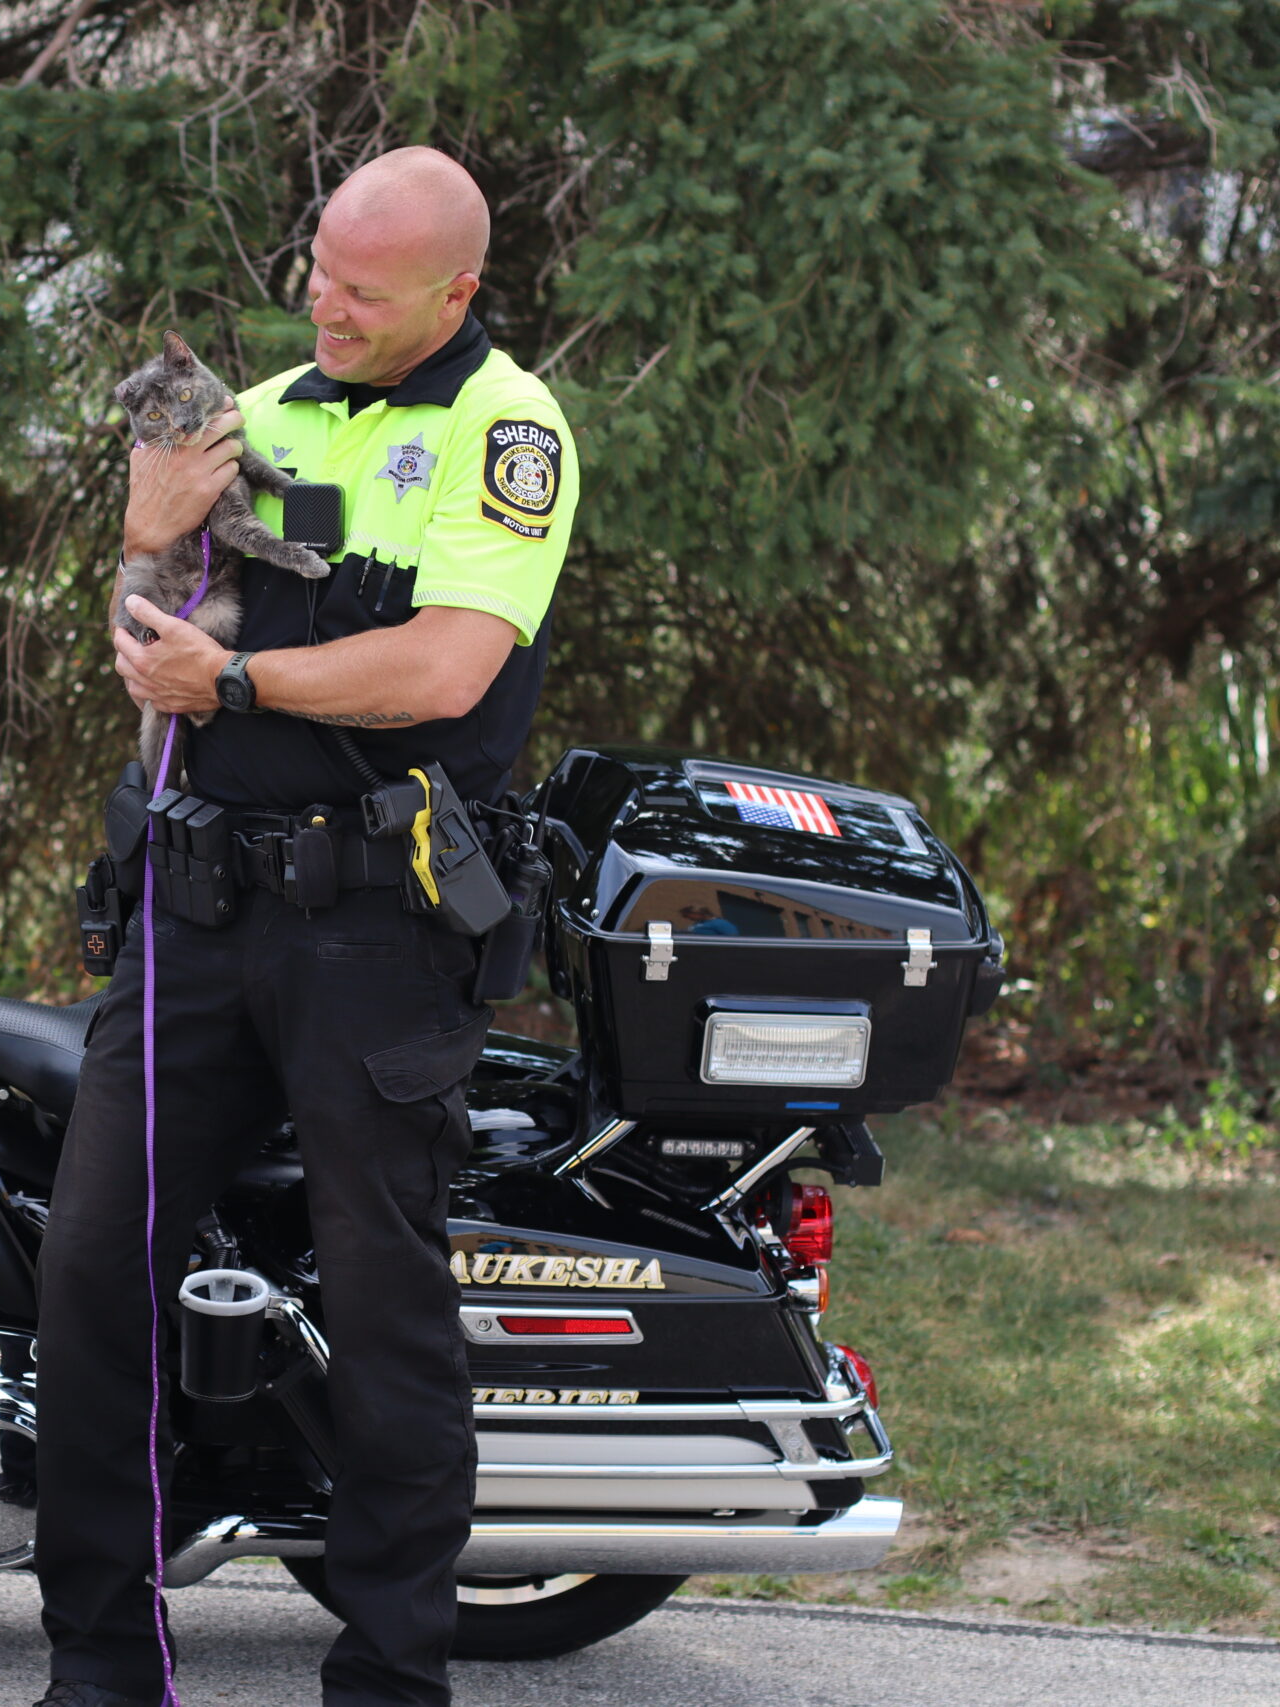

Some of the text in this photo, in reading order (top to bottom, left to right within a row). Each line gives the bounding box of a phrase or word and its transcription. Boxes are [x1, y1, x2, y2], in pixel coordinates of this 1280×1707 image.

[492, 425, 559, 455] SHERIFF
[500, 446, 552, 477] WAUKESHA COUNTY
[513, 454, 535, 464] STATE
[497, 477, 521, 501] SHERIFF
[502, 516, 543, 537] MOTOR UNIT
[449, 1250, 666, 1289] AUKESHA
